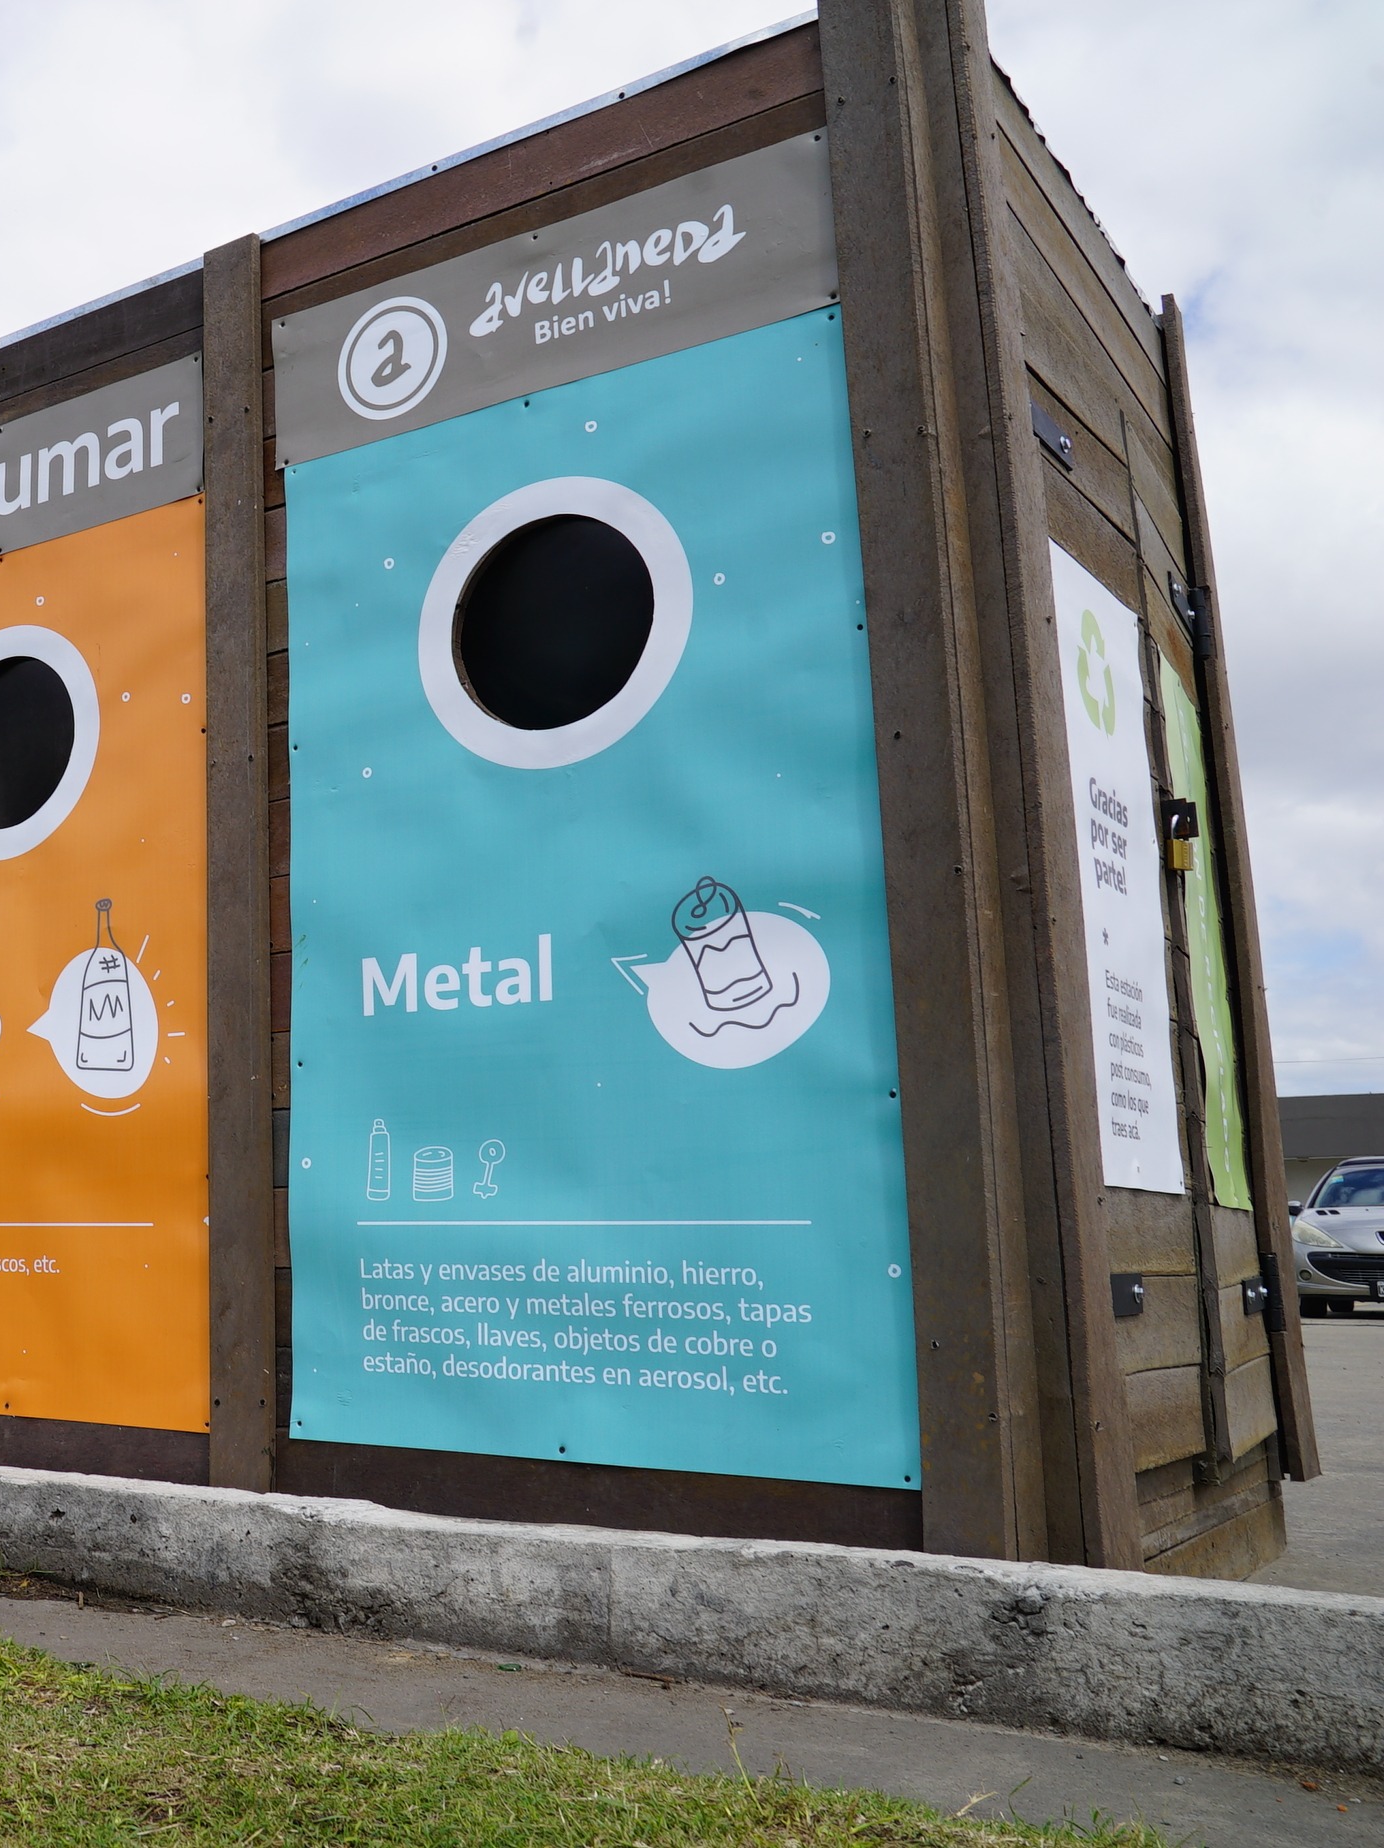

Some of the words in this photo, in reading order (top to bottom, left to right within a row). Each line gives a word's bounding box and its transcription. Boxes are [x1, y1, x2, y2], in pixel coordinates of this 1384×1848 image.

[534, 307, 594, 345] Bien
[602, 279, 671, 323] viva!
[1089, 777, 1128, 828] Gracias
[1091, 818, 1109, 850] por
[1111, 831, 1127, 860] ser
[1094, 857, 1127, 896] parte!
[361, 933, 553, 1017] Metal
[1105, 969, 1119, 992] Esta
[1120, 978, 1143, 1002] estación
[1107, 997, 1118, 1020] fue
[1109, 1032, 1119, 1049] con
[1111, 1091, 1126, 1110] como
[1127, 1089, 1136, 1112] los
[1137, 1098, 1149, 1118] que
[1111, 1116, 1127, 1138] traes
[33, 1255, 60, 1274] etc.
[360, 1258, 415, 1280] Latas
[419, 1263, 433, 1286] y
[438, 1262, 527, 1282] envases
[532, 1258, 561, 1282] de
[567, 1258, 675, 1289] aluminio,
[682, 1259, 764, 1291] hierro,
[361, 1287, 435, 1316] bronce,
[440, 1294, 500, 1314] acero
[505, 1297, 520, 1320] y
[526, 1292, 616, 1317] metales
[622, 1293, 732, 1325] ferrosos,
[737, 1297, 813, 1329] tapas
[362, 1318, 387, 1342] de
[391, 1319, 471, 1349] frascos,
[477, 1322, 547, 1352] llaves,
[553, 1325, 641, 1356] objetos
[647, 1328, 678, 1354] de
[684, 1329, 754, 1357] cobre
[761, 1338, 778, 1358] o
[362, 1351, 437, 1380] estaño,
[442, 1353, 596, 1384] desodorantes
[602, 1366, 631, 1386] en
[638, 1365, 735, 1396] aerosol,
[742, 1369, 789, 1395] etc.
